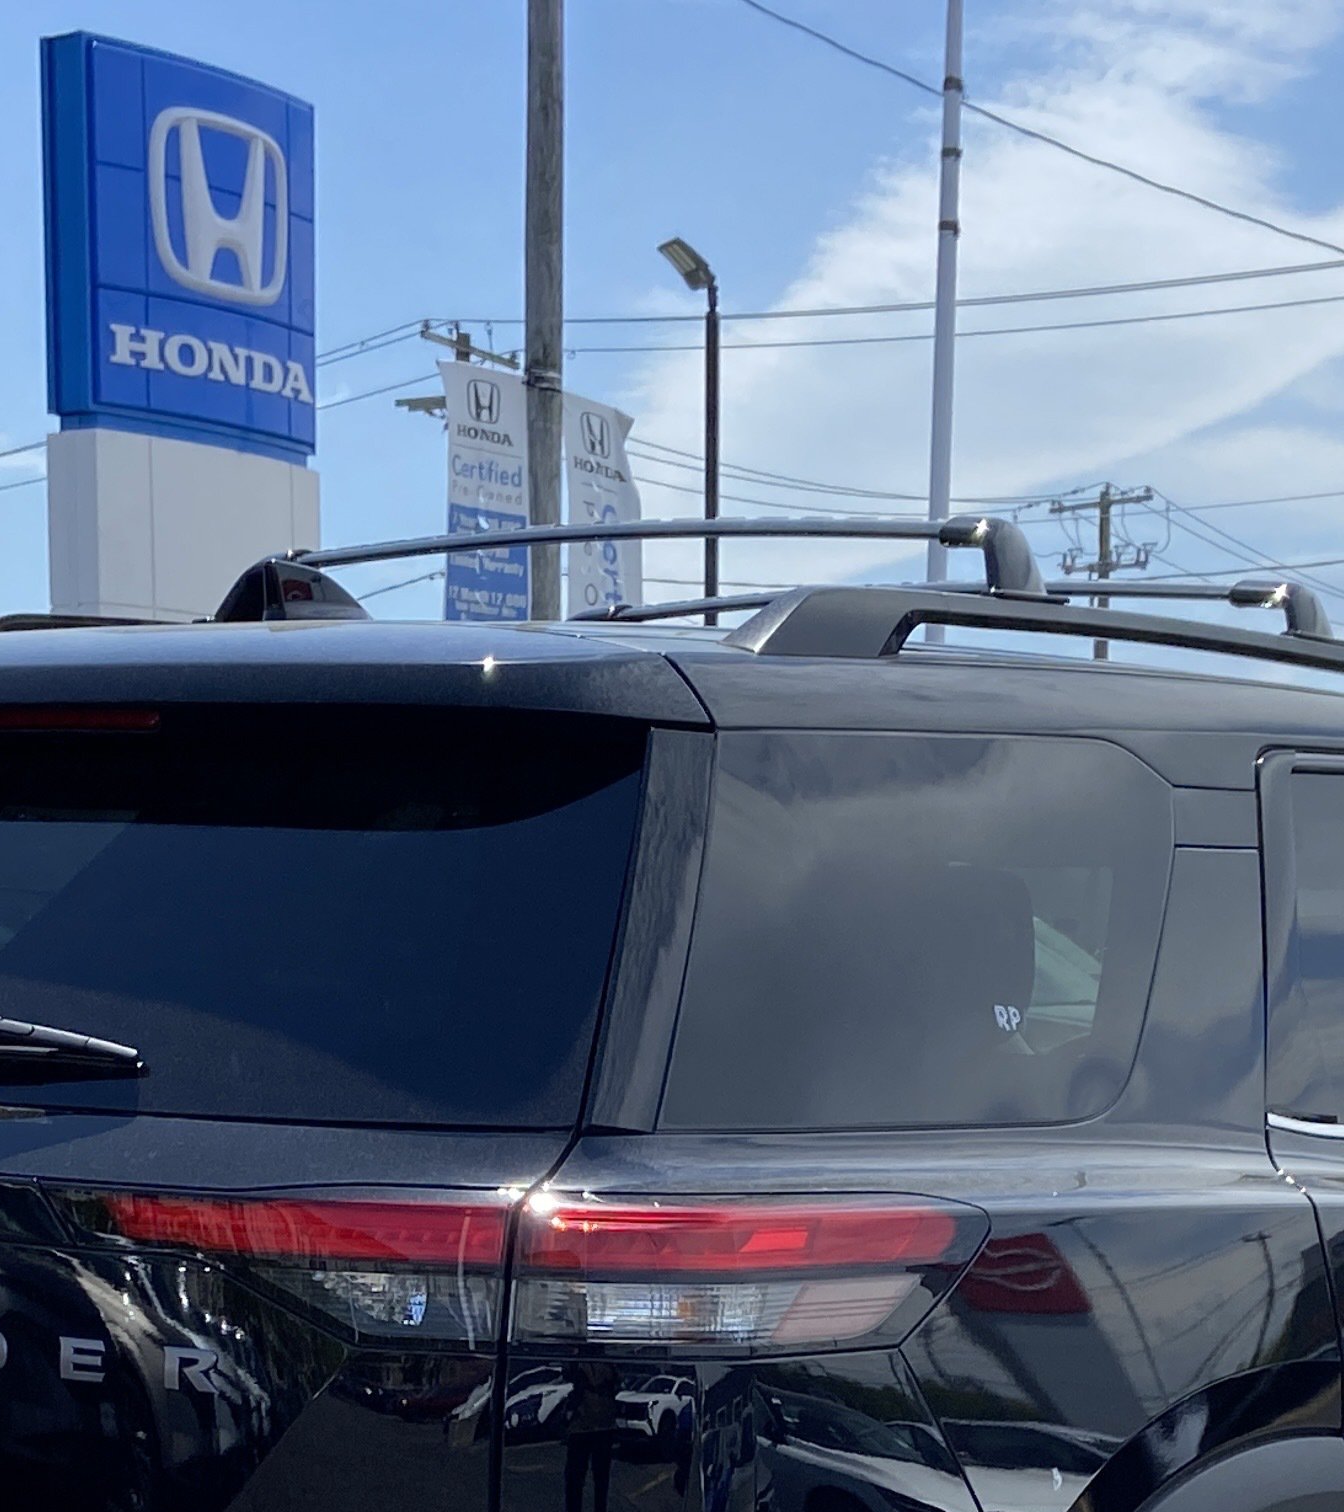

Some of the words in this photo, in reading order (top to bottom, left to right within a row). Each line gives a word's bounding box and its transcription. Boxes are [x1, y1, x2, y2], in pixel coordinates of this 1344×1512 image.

[109, 323, 313, 404] HONDA
[456, 424, 514, 447] HONDA
[574, 456, 627, 483] HONDA
